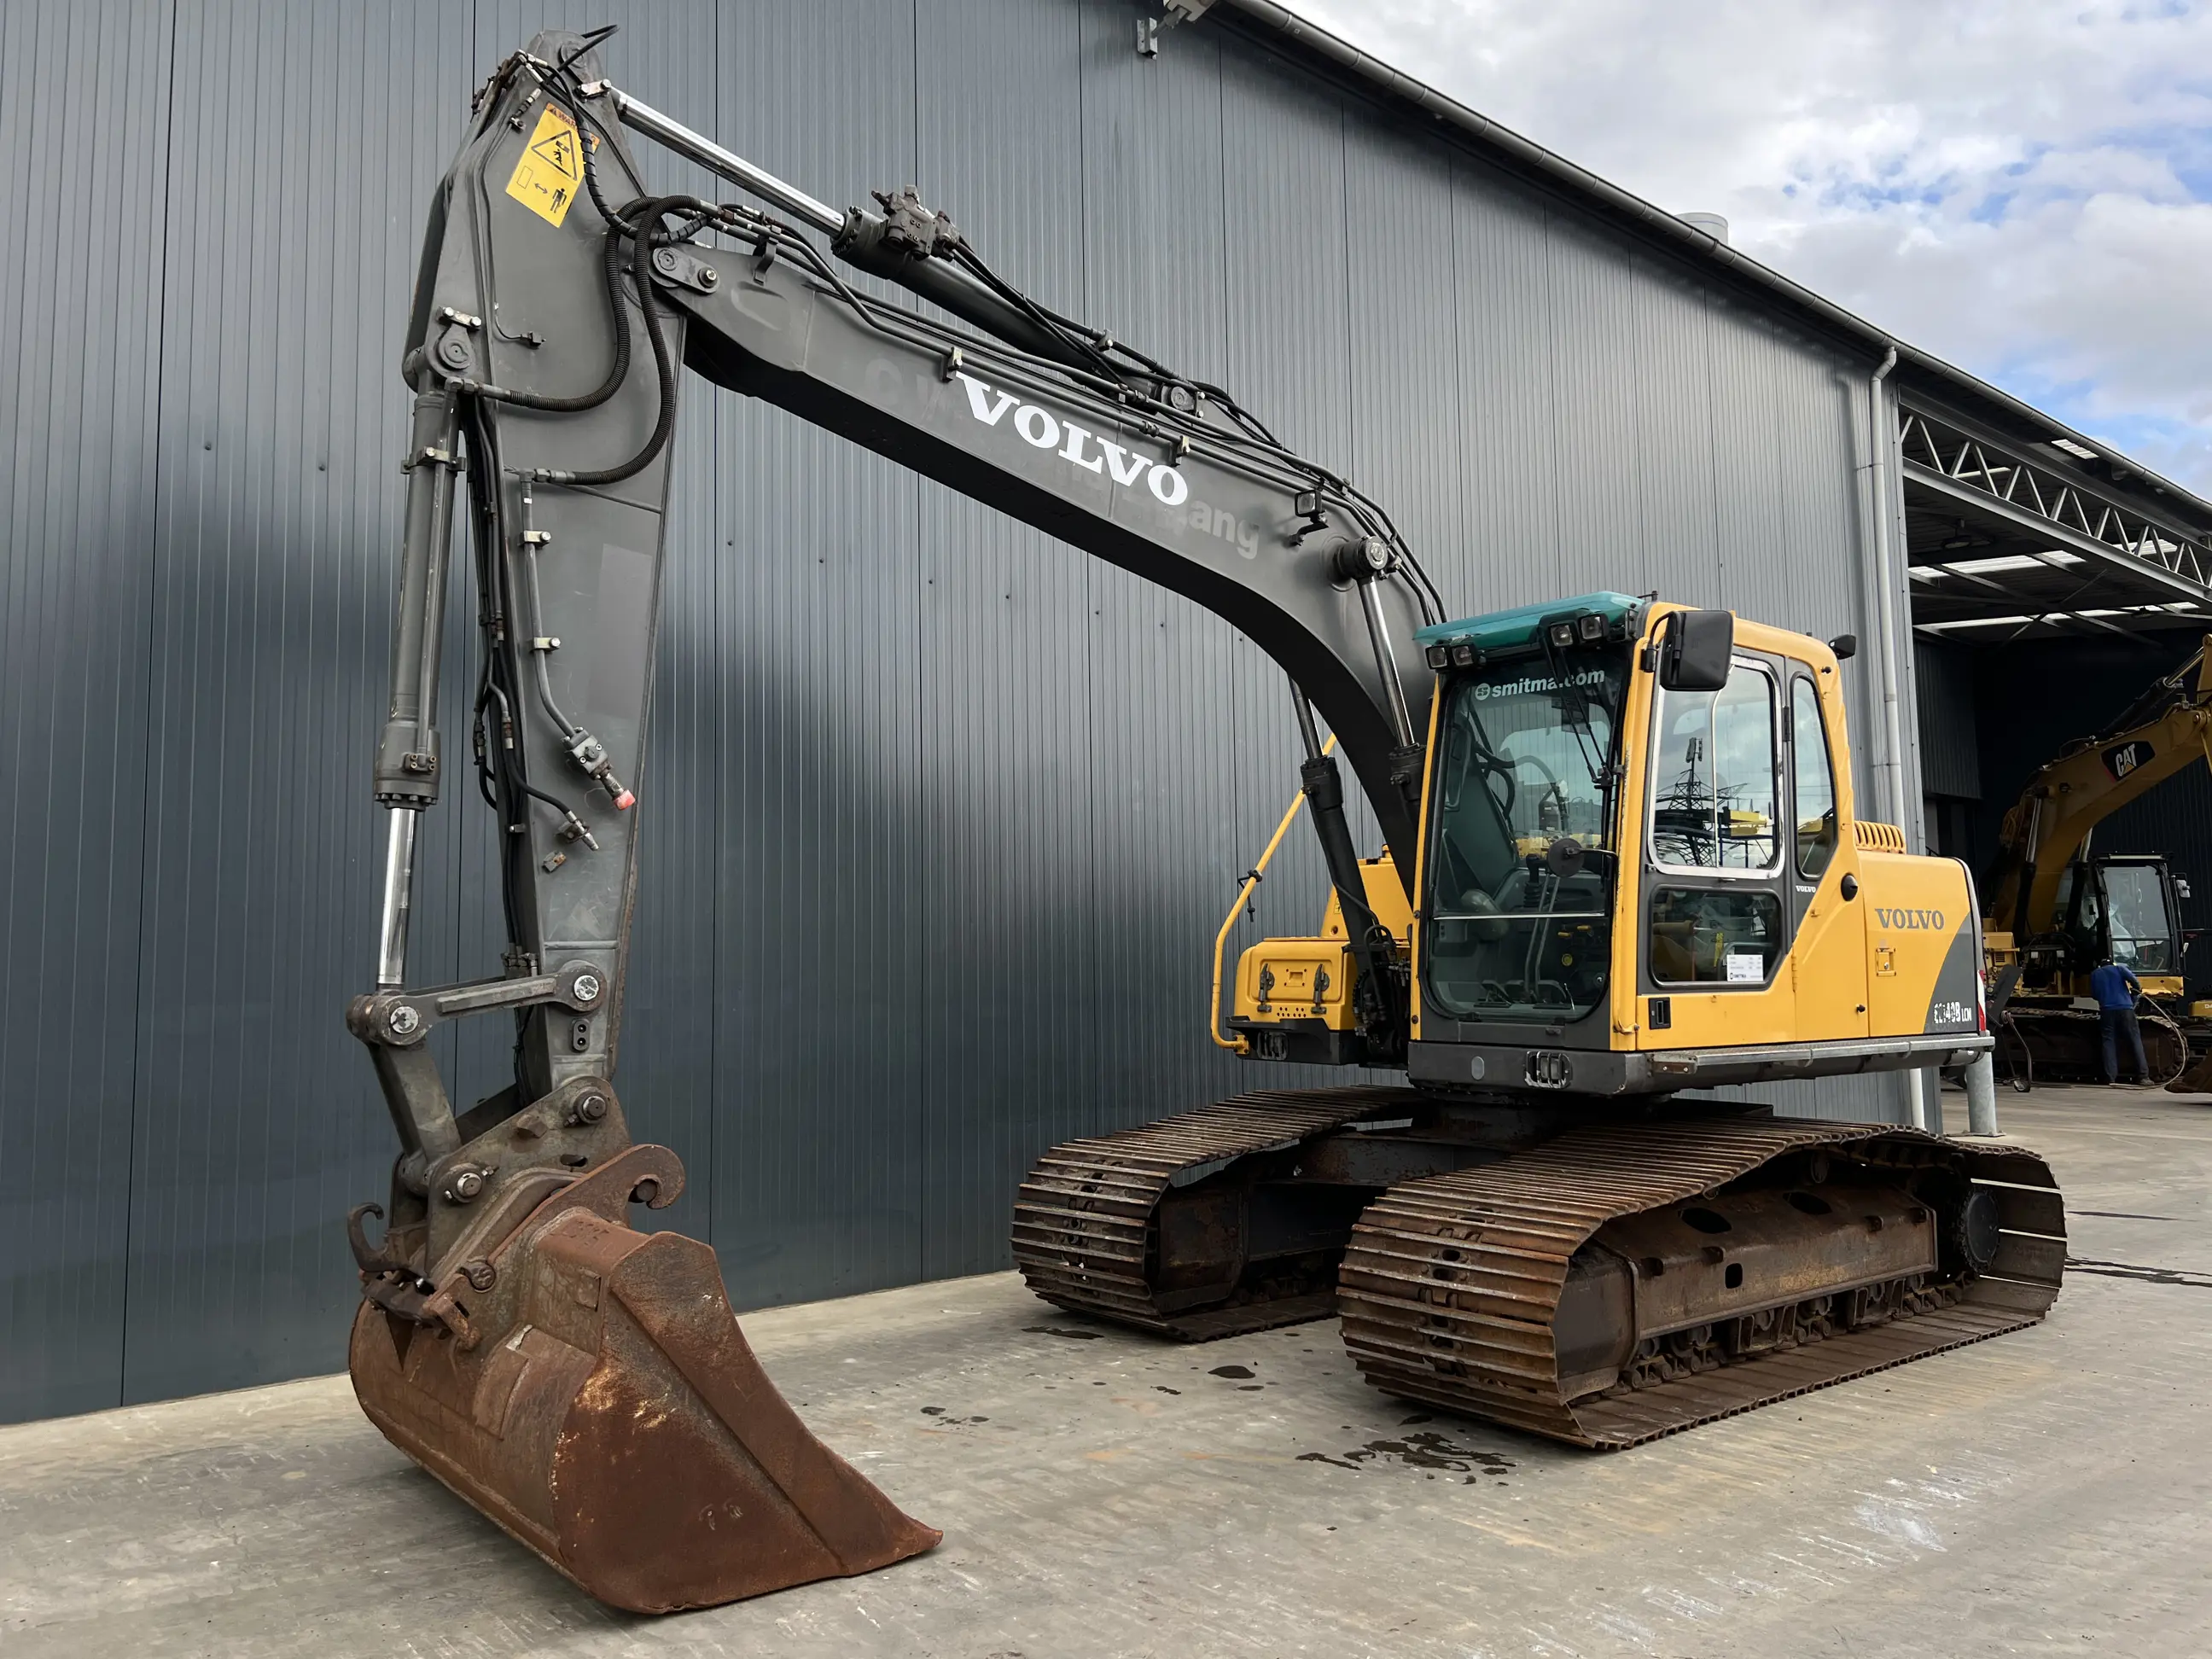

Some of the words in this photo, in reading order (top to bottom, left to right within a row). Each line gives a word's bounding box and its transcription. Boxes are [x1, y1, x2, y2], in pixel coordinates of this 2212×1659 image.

[956, 370, 1189, 505] VOLVO
[2116, 743, 2137, 777] CAT
[1874, 908, 1945, 930] VOLVO
